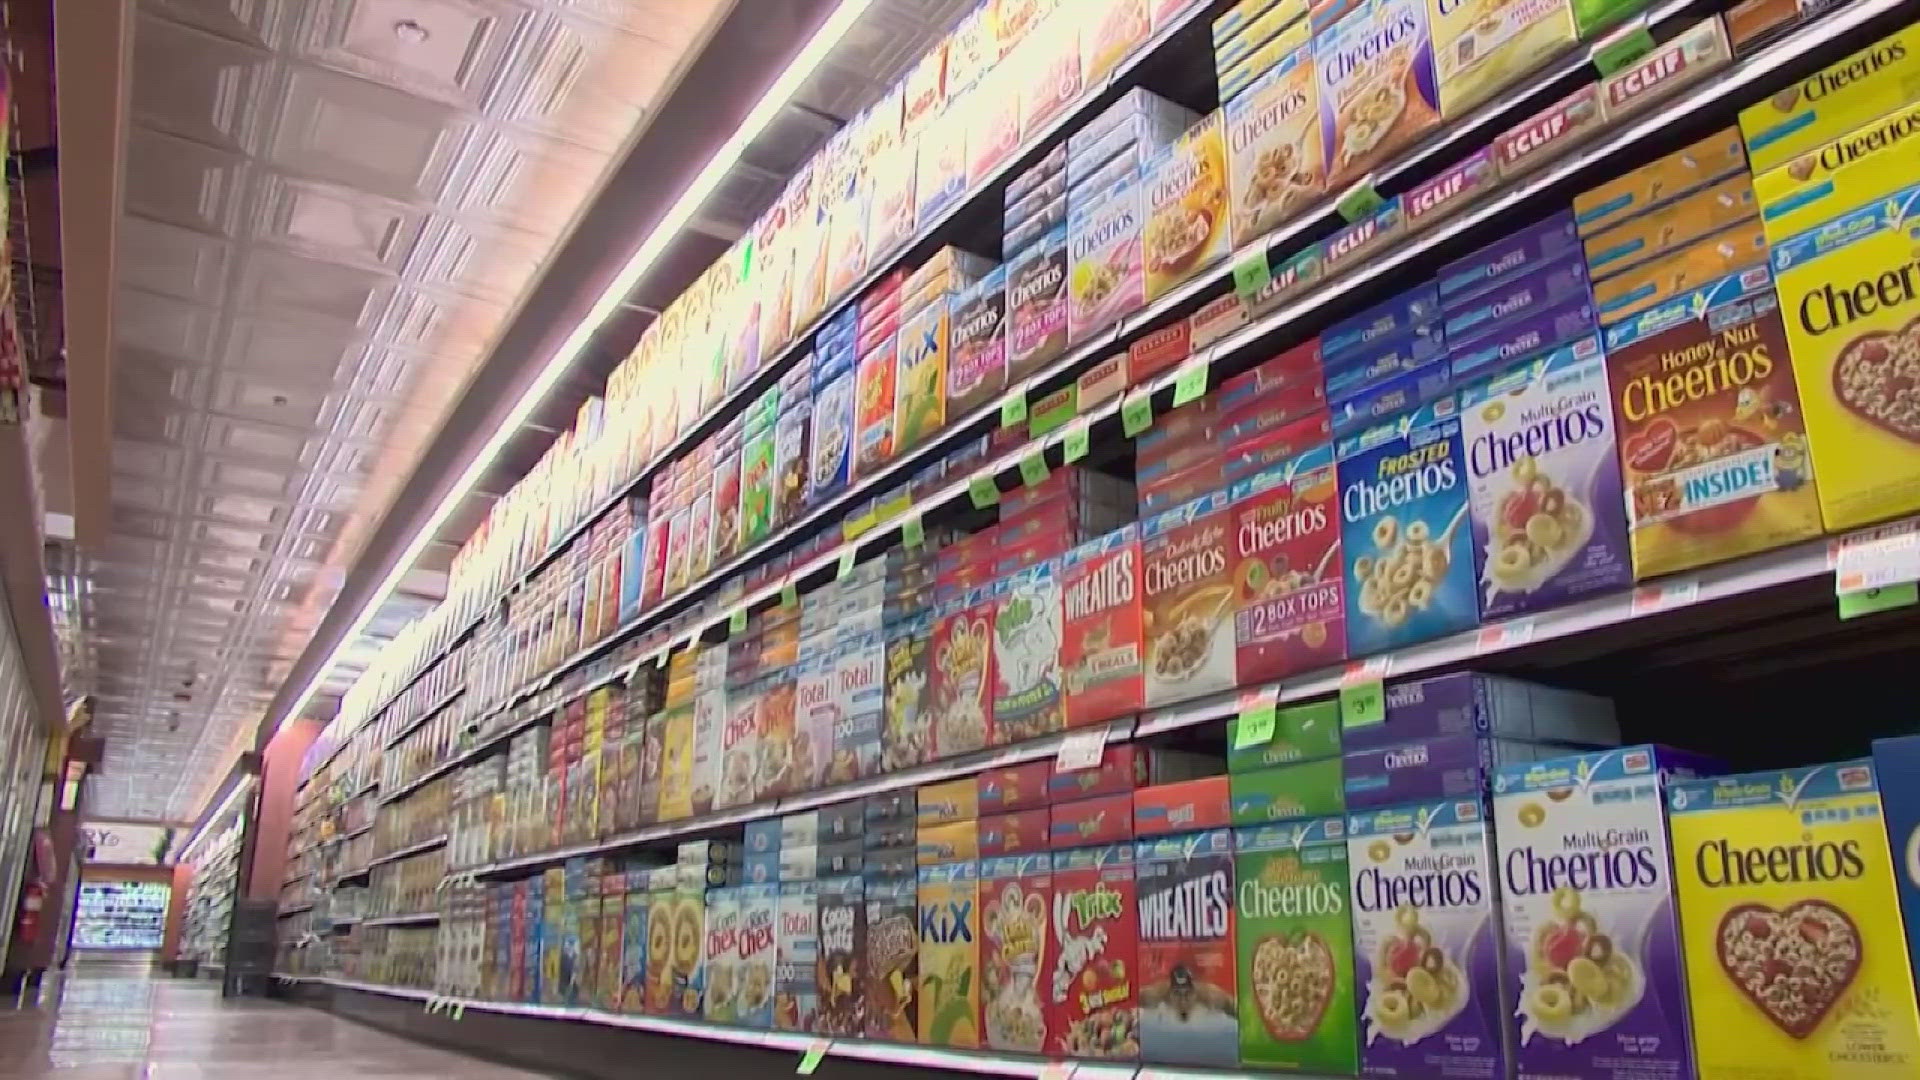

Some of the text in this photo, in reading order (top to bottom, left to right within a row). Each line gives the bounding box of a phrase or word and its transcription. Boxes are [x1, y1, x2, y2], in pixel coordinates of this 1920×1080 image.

[1326, 16, 1415, 86] Cheerios
[1803, 40, 1905, 102] Cheerios
[1232, 89, 1307, 153] Cheerios
[1820, 110, 1920, 172] Cheerios
[1073, 209, 1133, 261] Cheerios
[1011, 263, 1063, 311] Cheerios
[1661, 322, 1759, 372] Honey Nut
[1622, 343, 1773, 421] Cheerios
[1378, 443, 1449, 479] FROSTED
[1471, 403, 1604, 478] Cheerios
[1343, 459, 1456, 523] Cheerios
[1684, 459, 1771, 504] INSIDE!
[1238, 504, 1327, 558] Cheerios
[1064, 550, 1134, 622] WHEATIES
[1145, 546, 1226, 596] Cheerios
[1253, 605, 1267, 636] 2
[1267, 598, 1296, 623] BOX
[1300, 586, 1339, 612] TOPS
[800, 678, 830, 709] Total
[840, 660, 874, 695] Total
[1438, 853, 1476, 869] Grain
[1562, 827, 1650, 850] Multi Grain
[1695, 833, 1865, 889] Cheerios
[1356, 866, 1482, 912] Cheerios
[1505, 845, 1658, 896] Cheerios
[782, 911, 812, 937] Total
[1139, 870, 1228, 940] WHEATIES
[1239, 879, 1343, 919] Cheerios
[707, 925, 737, 960] Chex
[739, 923, 775, 960] Chex
